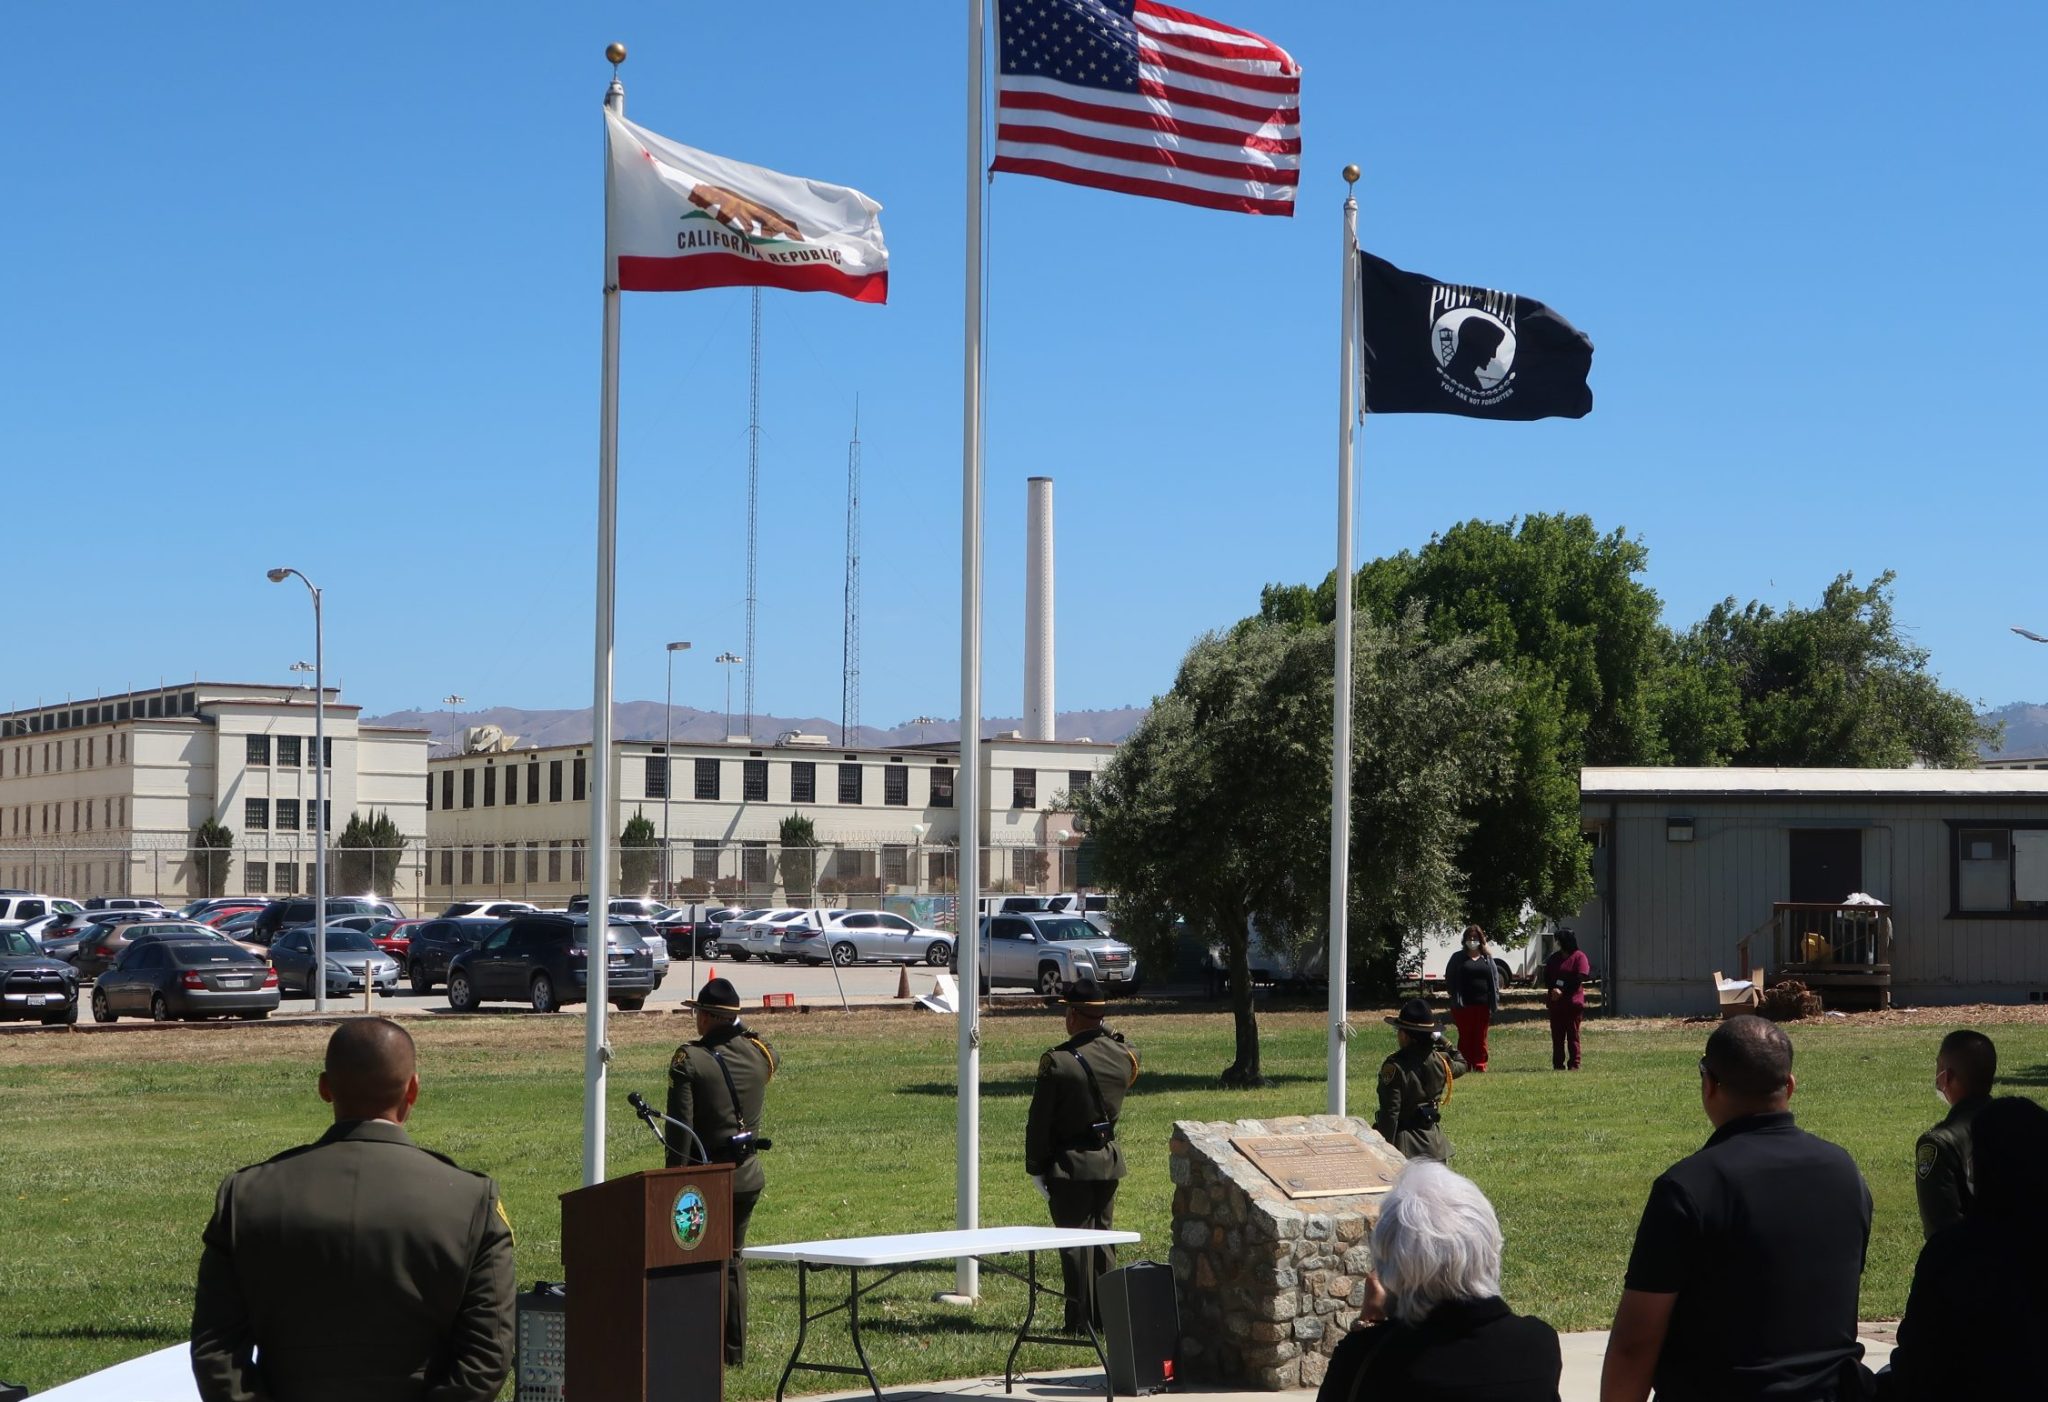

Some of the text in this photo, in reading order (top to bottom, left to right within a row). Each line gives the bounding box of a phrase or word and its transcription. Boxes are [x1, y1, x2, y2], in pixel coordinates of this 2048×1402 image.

[677, 230, 842, 264] CALIFORNIA REPUBLIC
[1429, 285, 1517, 335] POW MIA
[1440, 381, 1454, 393] YOU
[1456, 390, 1467, 401] ARE
[1481, 388, 1514, 405] FORGOTTEN
